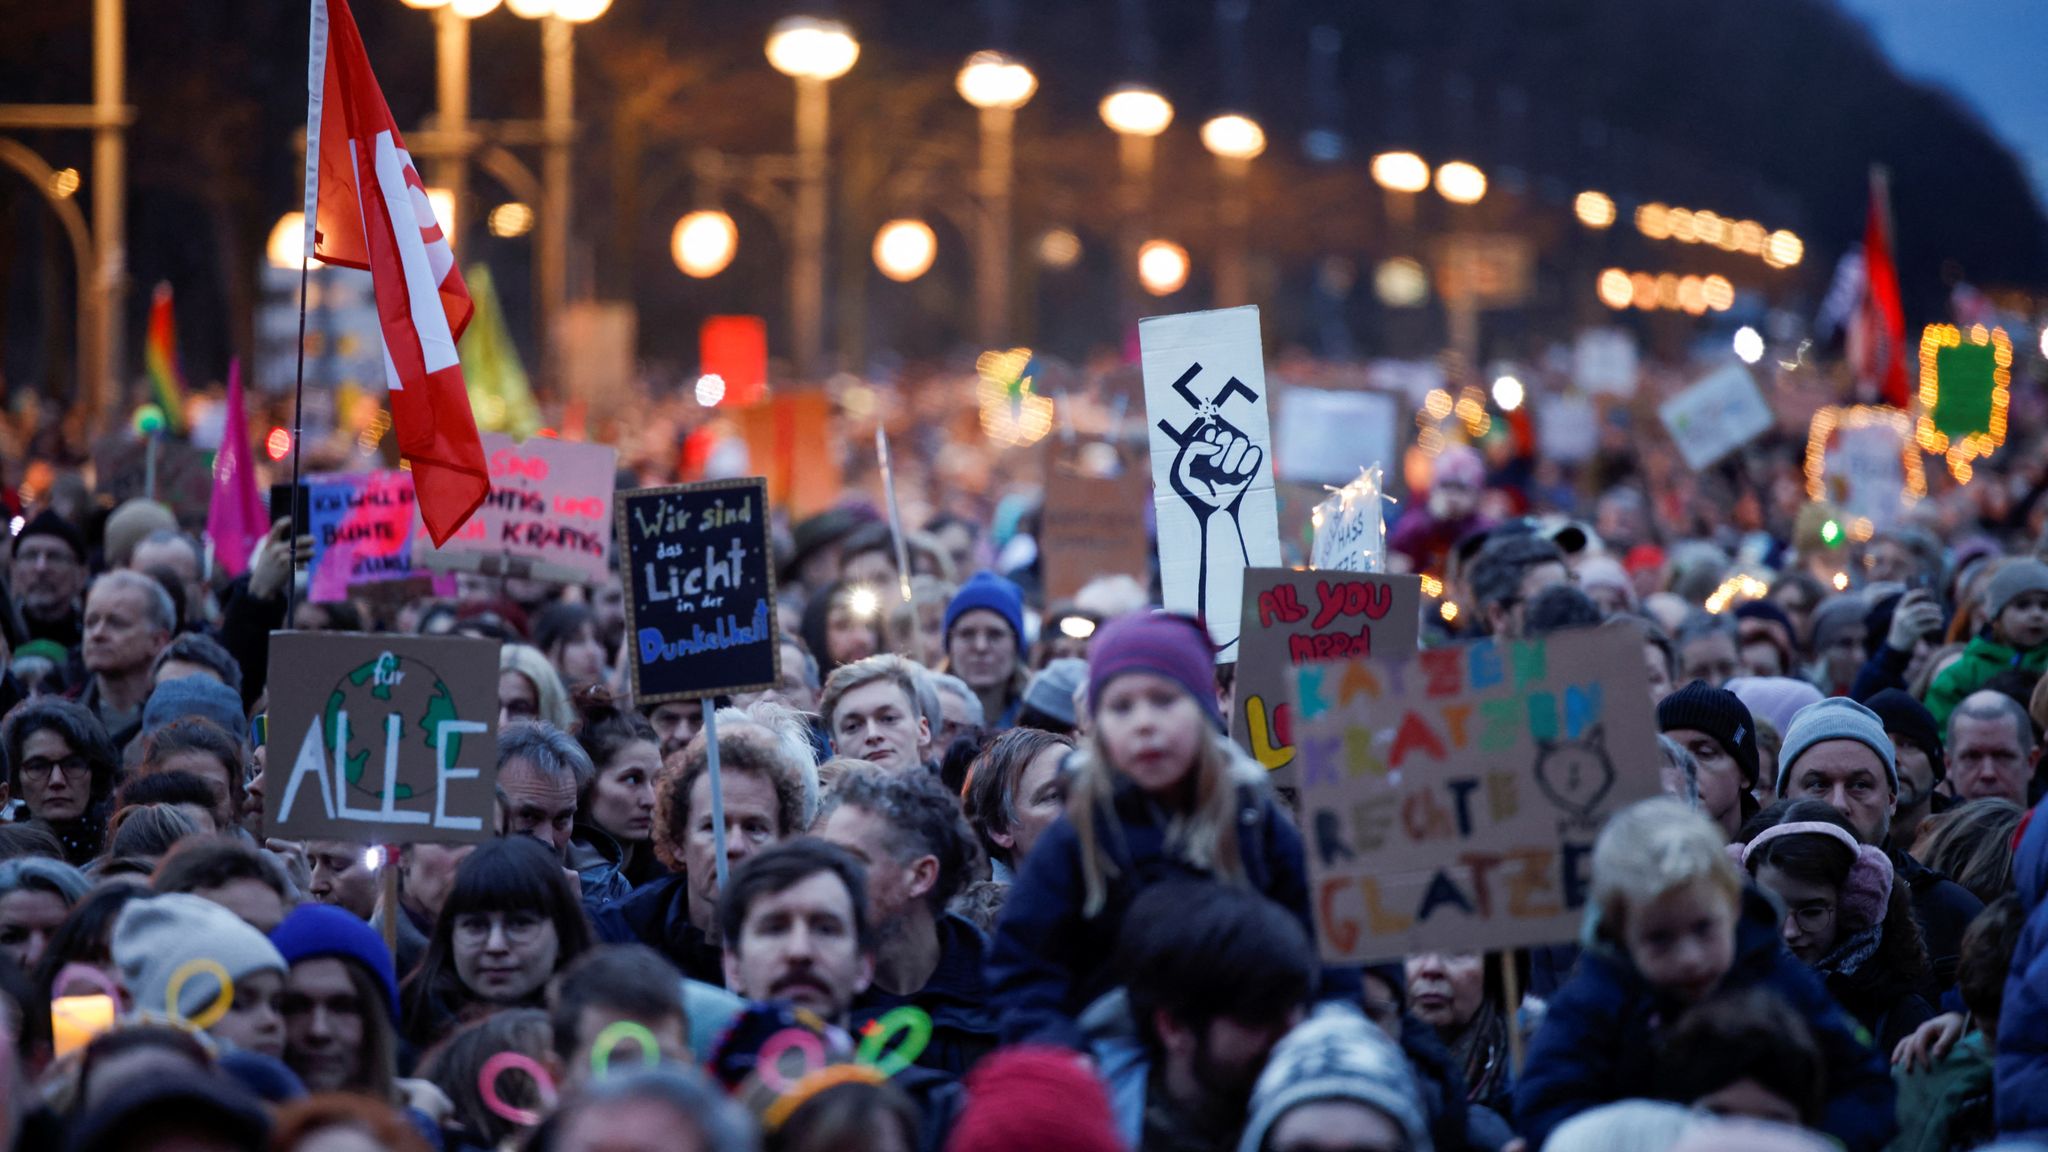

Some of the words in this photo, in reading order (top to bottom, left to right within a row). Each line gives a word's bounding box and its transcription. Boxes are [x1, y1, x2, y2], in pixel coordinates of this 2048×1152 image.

[635, 499, 692, 539] Wir
[699, 496, 752, 531] sind
[645, 537, 746, 601] Licht
[656, 542, 683, 559] das
[638, 598, 769, 664] Dunkelheit
[677, 598, 695, 613] in
[701, 595, 724, 609] der
[1297, 638, 1547, 722] KATZEN
[276, 710, 488, 830] ALLE
[1319, 842, 1594, 955] GLATZE
